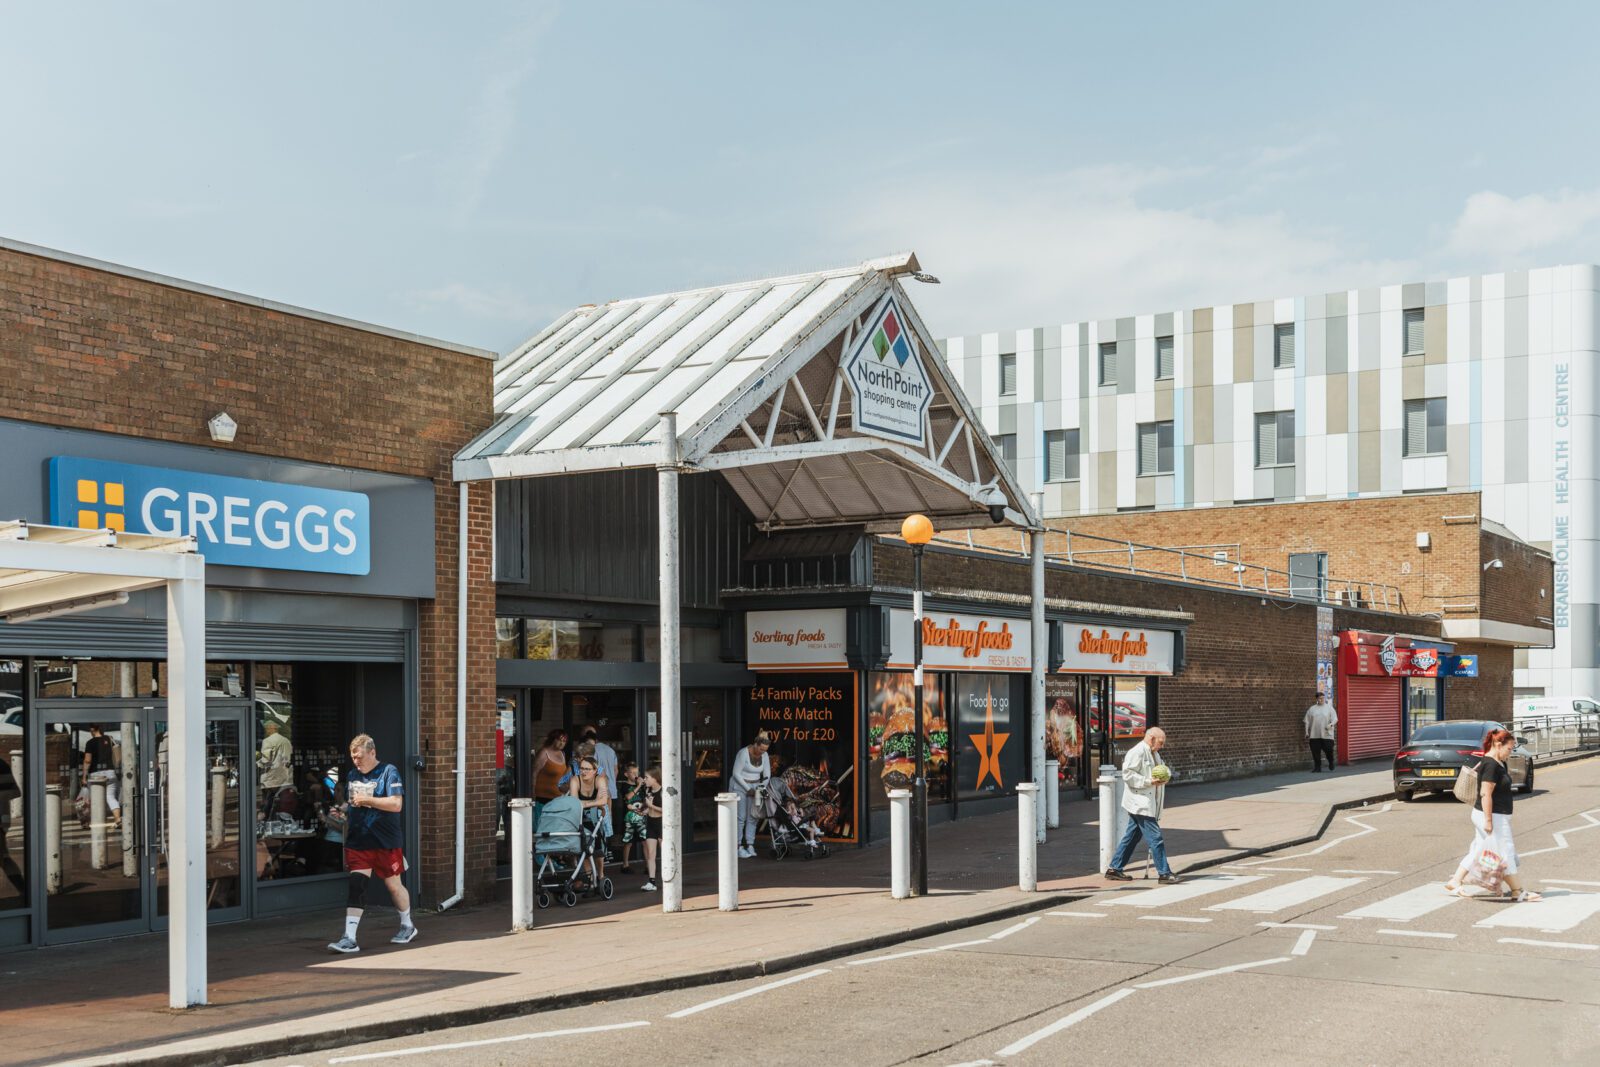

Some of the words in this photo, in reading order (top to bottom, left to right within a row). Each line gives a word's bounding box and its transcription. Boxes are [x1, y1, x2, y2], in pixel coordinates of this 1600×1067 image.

[864, 387, 895, 409] shopping
[896, 398, 917, 413] centre
[1555, 362, 1569, 428] CENTRE
[1555, 440, 1569, 504] HEALTH
[141, 487, 357, 556] GREGGS
[1555, 515, 1569, 628] BRANSHOLME
[752, 629, 794, 646] Sterling
[794, 629, 825, 646] foods
[921, 617, 977, 658] Sterling
[974, 620, 1013, 657] foods
[1079, 628, 1121, 663] Sterling
[1118, 631, 1148, 663] foods
[751, 687, 765, 700] £4
[767, 686, 806, 703] Family
[808, 686, 843, 700] Packs
[969, 692, 988, 708] Food
[999, 697, 1009, 712] go
[759, 707, 780, 720] Mix
[783, 707, 792, 720] &
[795, 707, 833, 720] Match
[783, 727, 790, 740] 7
[793, 726, 809, 740] for
[812, 727, 835, 741] £20
